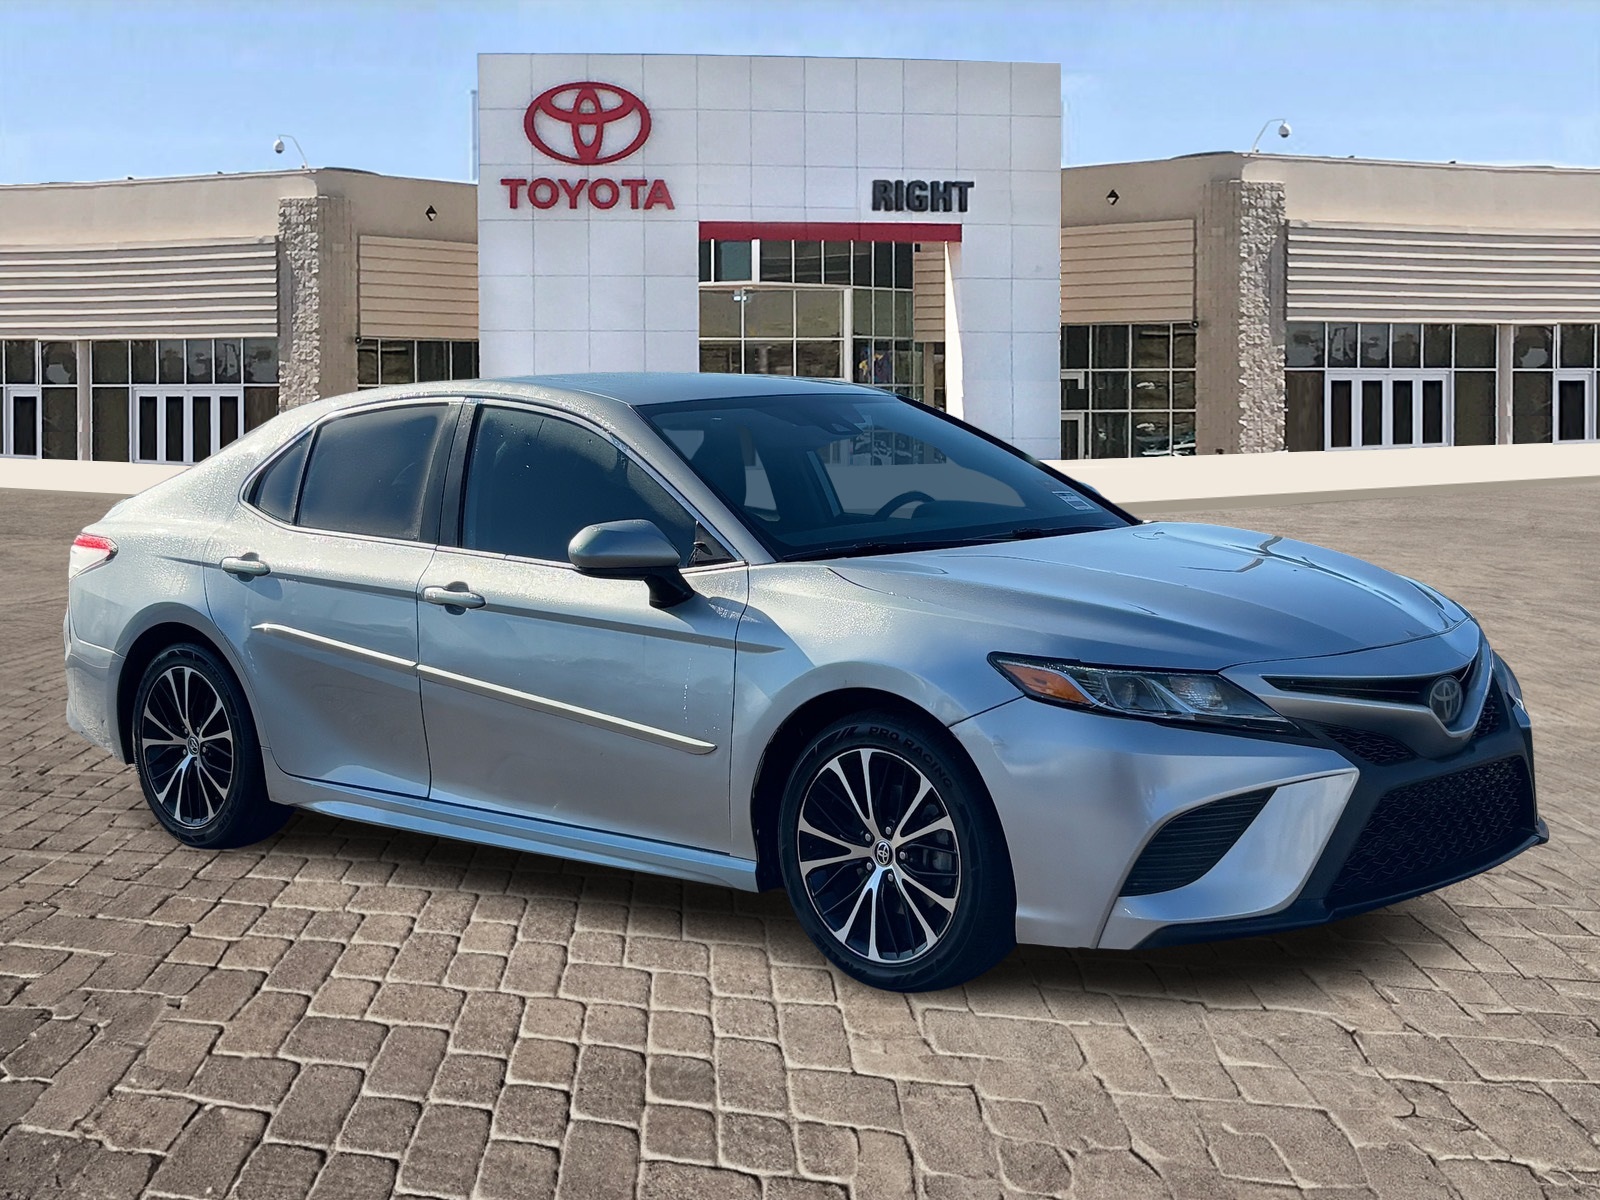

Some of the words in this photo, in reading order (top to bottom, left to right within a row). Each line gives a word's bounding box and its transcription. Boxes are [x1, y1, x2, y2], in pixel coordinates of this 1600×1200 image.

[500, 178, 675, 210] TOYOTA
[871, 180, 975, 212] RIGHT
[868, 726, 900, 741] PRO
[903, 738, 953, 788] RACING
